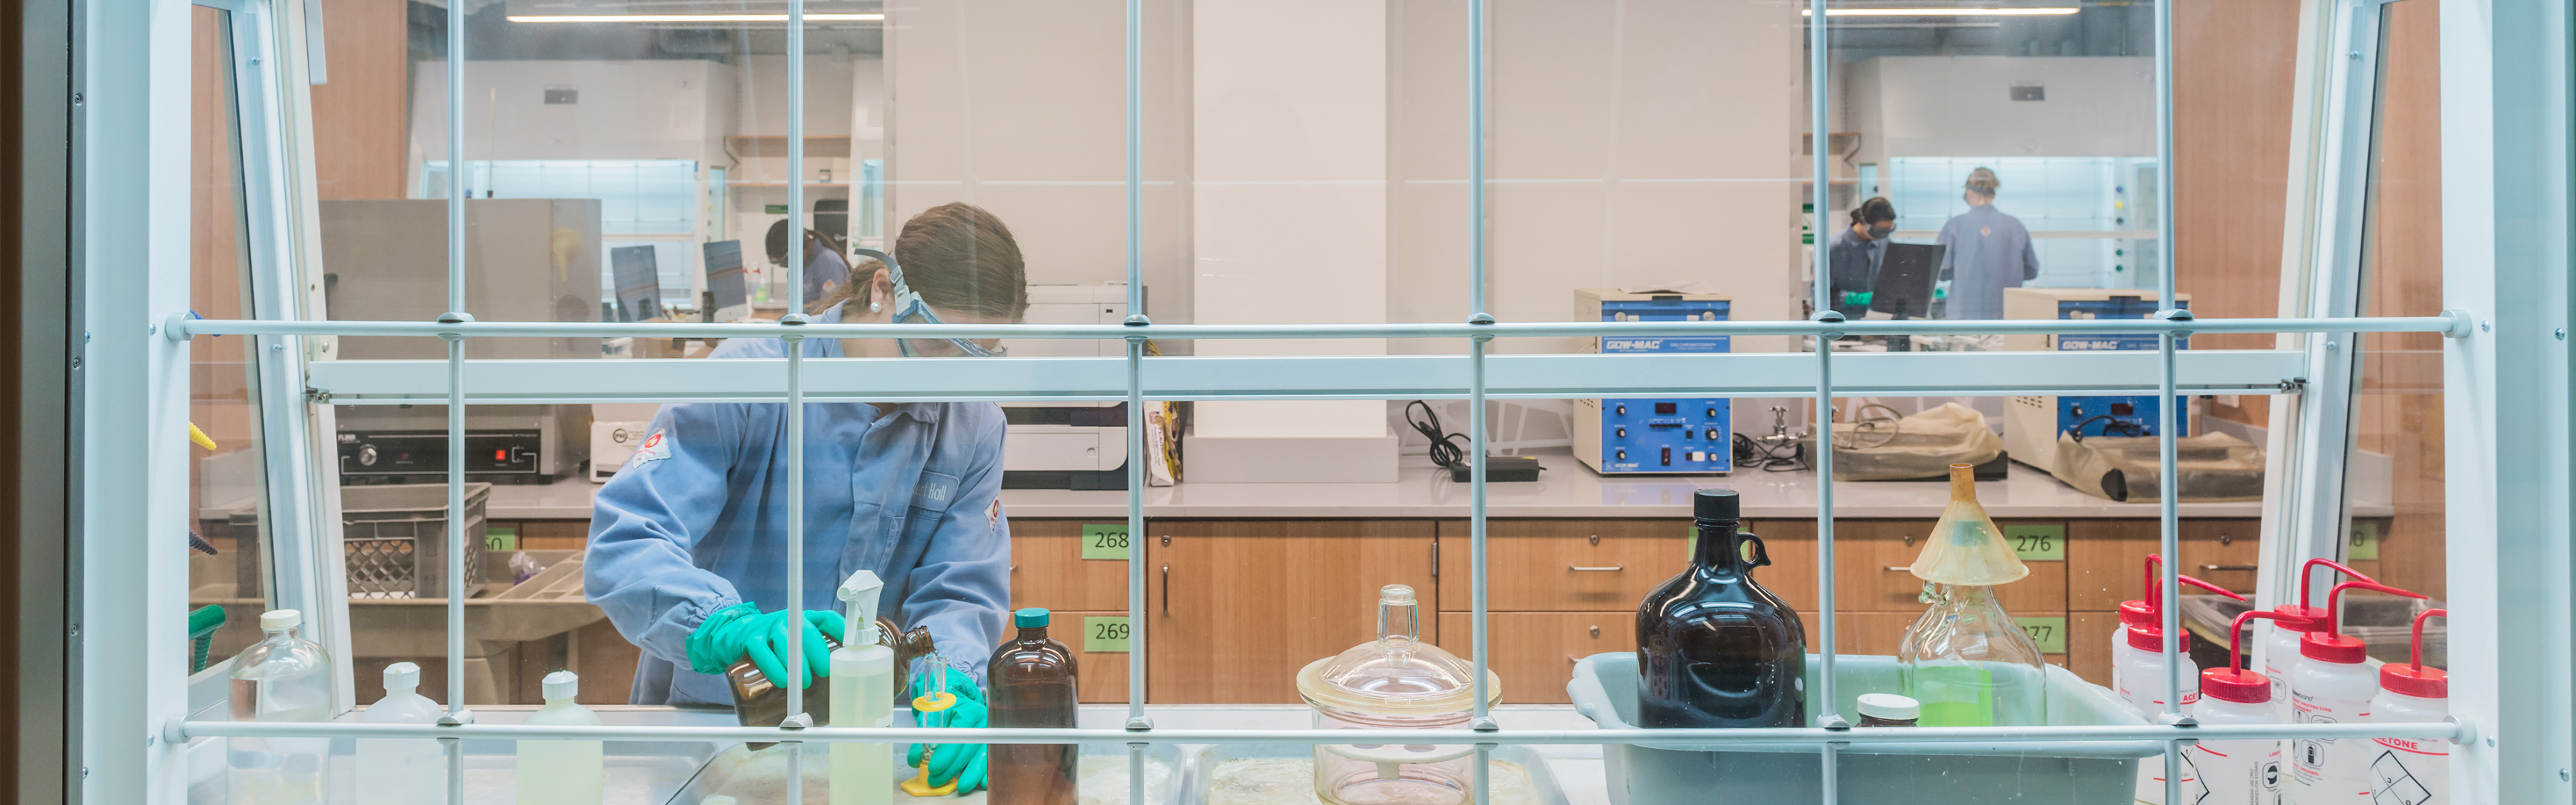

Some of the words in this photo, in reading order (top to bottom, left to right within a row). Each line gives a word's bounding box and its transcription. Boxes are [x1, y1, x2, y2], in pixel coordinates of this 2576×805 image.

[1606, 340, 1660, 350] GOW-MAC
[2062, 341, 2118, 350] GOW-MAC
[928, 482, 947, 502] Hall
[1095, 532, 1129, 548] 268
[2016, 536, 2052, 552] 276
[1096, 623, 1130, 640] 269
[2022, 625, 2053, 643] 77
